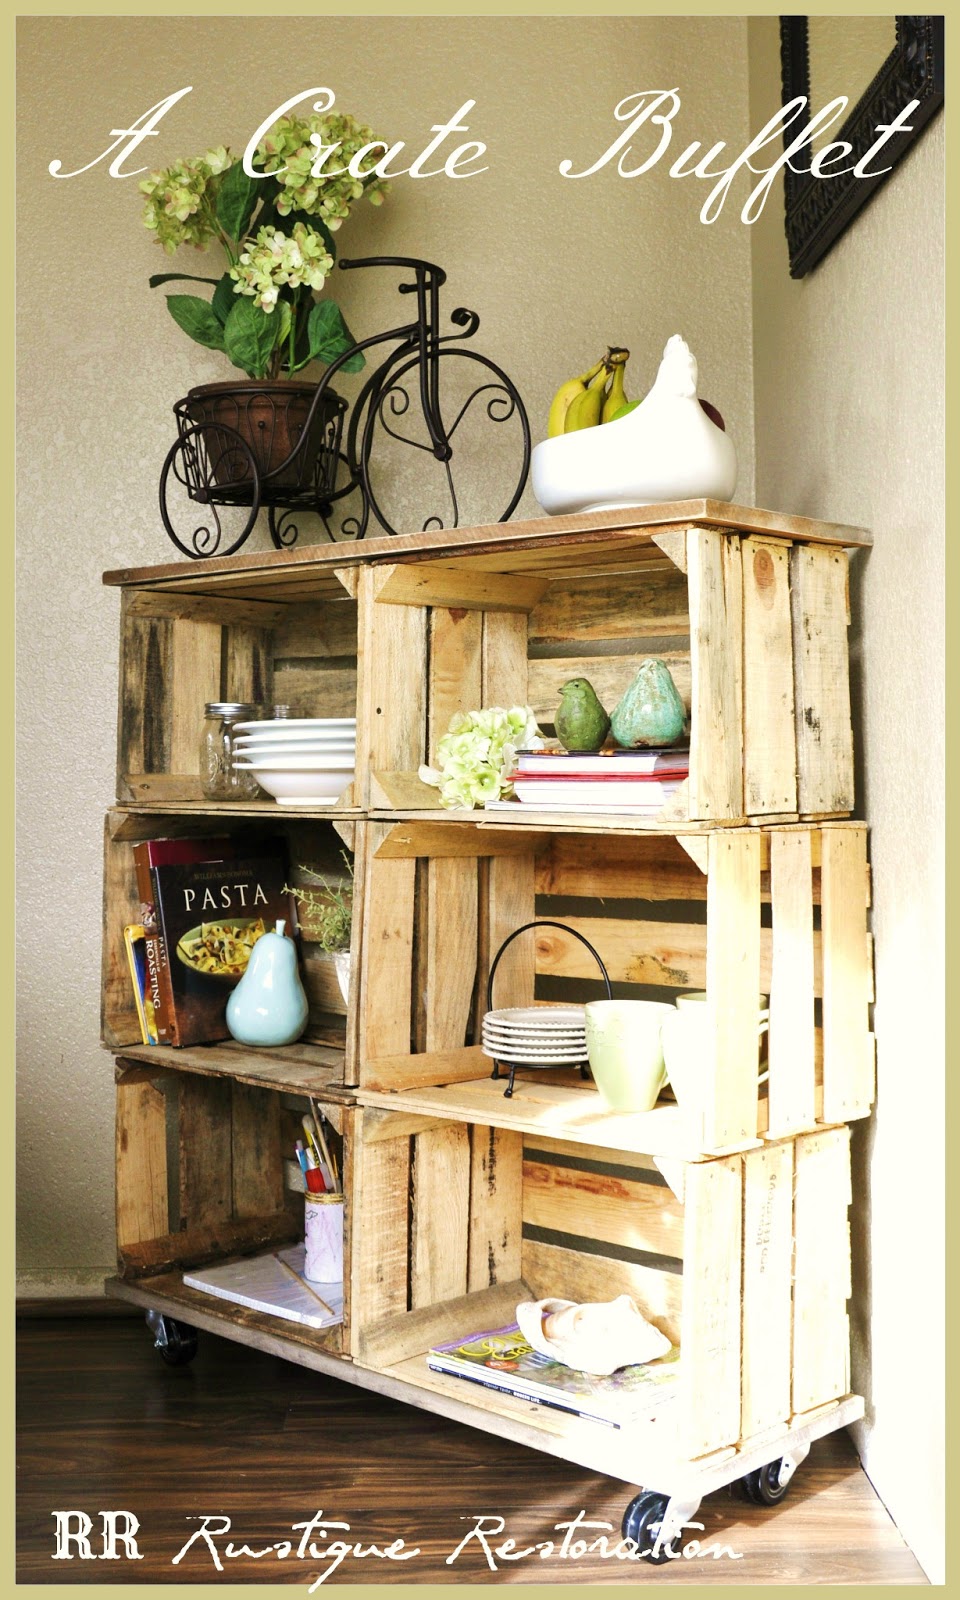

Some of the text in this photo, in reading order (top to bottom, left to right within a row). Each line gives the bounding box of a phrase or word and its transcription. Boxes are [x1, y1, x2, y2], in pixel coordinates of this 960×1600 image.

[183, 884, 269, 911] PASTA
[158, 936, 166, 967] PASTA
[145, 940, 161, 1009] ROASTING
